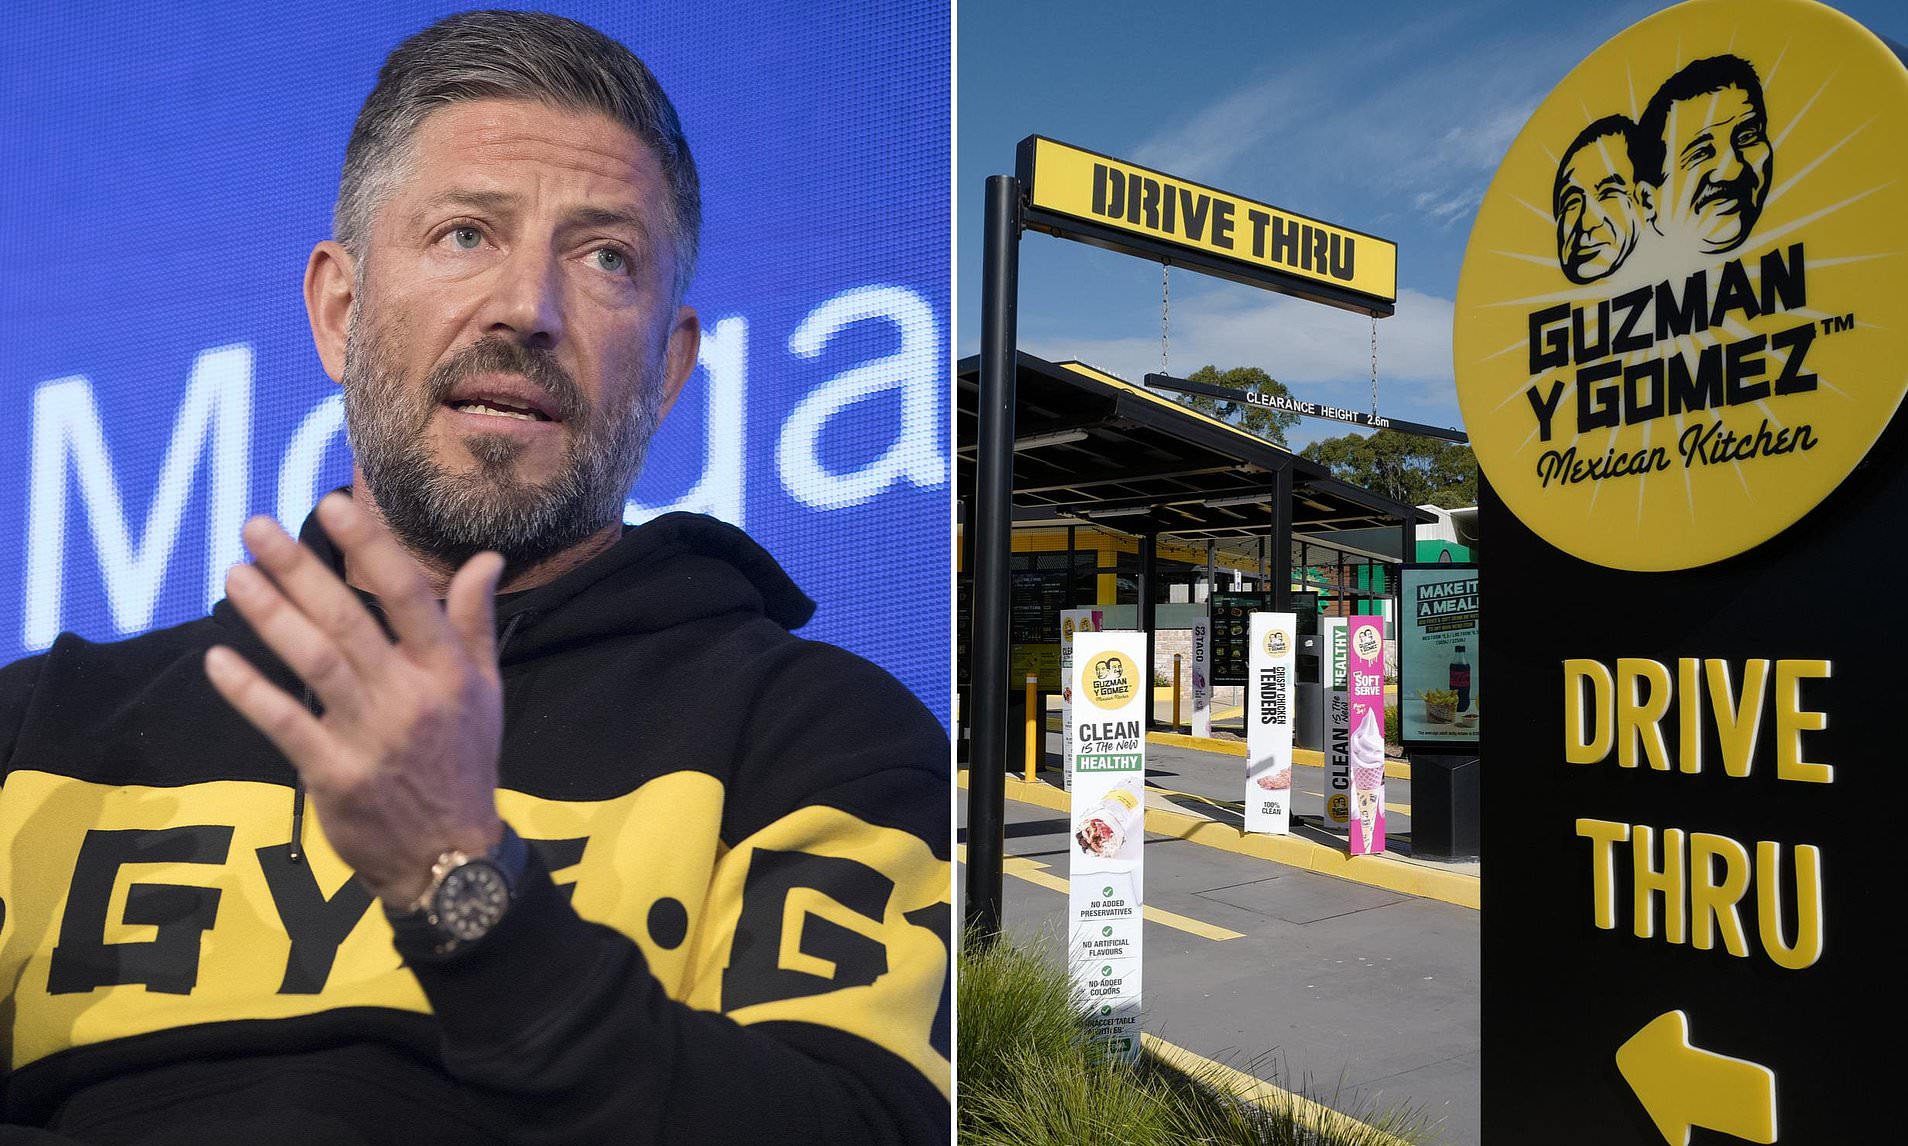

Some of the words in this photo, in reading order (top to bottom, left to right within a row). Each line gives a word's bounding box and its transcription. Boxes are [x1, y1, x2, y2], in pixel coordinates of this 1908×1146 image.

[1091, 162, 1236, 250] DRIVE
[1248, 208, 1356, 282] THRU
[1528, 242, 1807, 375] GUZMAN
[1526, 379, 1565, 442] Y
[1576, 322, 1818, 434] GOMEZ
[1246, 391, 1316, 414] CLEARANCE
[1321, 406, 1359, 422] HEIGHT
[1367, 414, 1390, 428] 2.6m
[1536, 443, 1671, 488] Mexican
[1678, 419, 1818, 469] Kitchen
[1420, 582, 1464, 599] MAKE
[1466, 580, 1479, 593] IT
[1420, 603, 1431, 616] A
[1195, 636, 1204, 662] TACO
[1335, 629, 1347, 687] HEALTHY
[1093, 677, 1128, 689] GUZMAN
[1276, 666, 1286, 692] CRISPY
[1354, 675, 1380, 687] SOFT
[1100, 685, 1129, 696] GOMEZ
[1260, 666, 1277, 725] TENDERS
[1354, 686, 1381, 696] SERVE
[1277, 692, 1287, 725] CHICKEN
[1564, 657, 1834, 784] DRIVE
[1079, 720, 1140, 742] CLEAN
[1080, 755, 1139, 770] HEALTHY
[1332, 727, 1349, 790] CLEAN
[1261, 807, 1282, 815] CLEAN
[1102, 900, 1125, 908] ADDED
[1575, 818, 1824, 970] THRU
[1080, 908, 1133, 918] PRESERVATIVES
[1082, 941, 1093, 949] NO
[1094, 939, 1130, 948] ARTIFICIAL
[1089, 948, 1123, 957] FLAVOURS
[1089, 980, 1099, 988] NO
[1101, 979, 1123, 987] ADDED
[1090, 987, 1121, 996] COLOURS
